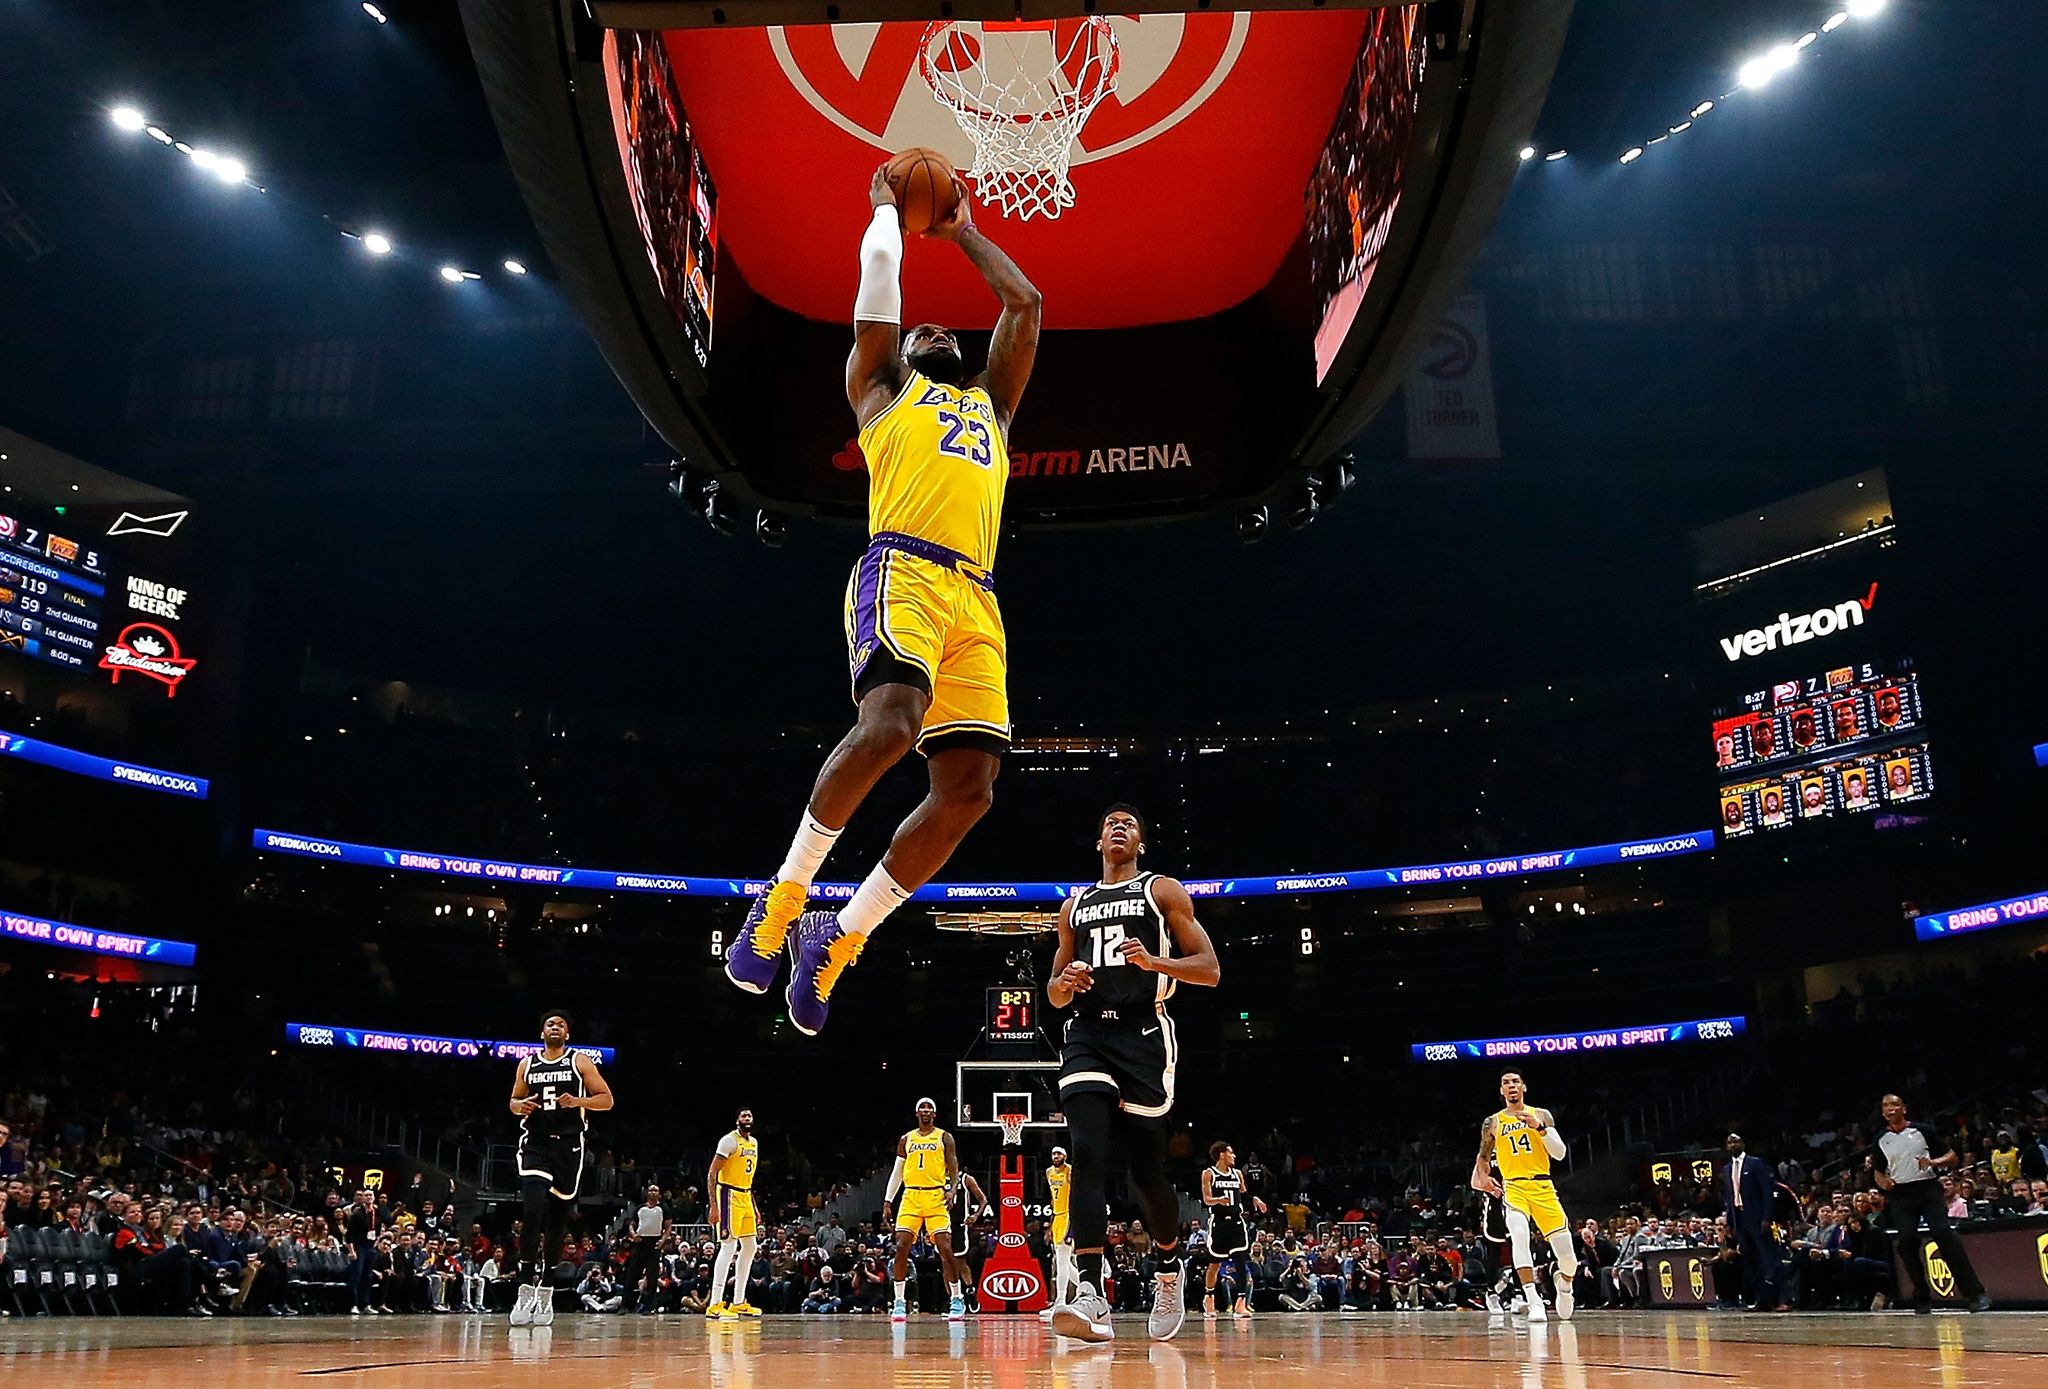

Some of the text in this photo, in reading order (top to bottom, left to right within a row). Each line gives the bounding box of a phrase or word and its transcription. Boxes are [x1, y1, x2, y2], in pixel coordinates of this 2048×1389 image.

[938, 411, 993, 470] 23
[1009, 443, 1192, 477] arm ARENA
[26, 528, 39, 543] 7
[86, 551, 98, 567] 5
[20, 575, 86, 607] 119 FINAL
[126, 575, 187, 605] KING OF
[20, 596, 98, 631] 59 2nd QUARTER
[128, 592, 180, 620] BEERS.
[21, 617, 33, 631] 6
[57, 632, 93, 649] QUARTER
[1720, 600, 1864, 662] verizon
[105, 646, 187, 676] Budweiser
[1744, 691, 1766, 704] 8:27
[1806, 677, 1817, 691] 7
[1862, 663, 1872, 677] 5
[400, 854, 441, 870] BRING
[443, 859, 482, 875] YOUR
[485, 863, 517, 879] OWN
[520, 868, 562, 882] SPIRIT
[825, 885, 854, 897] OWN
[1184, 882, 1223, 895] SPIRIT
[1402, 867, 1441, 882] BRING
[1444, 864, 1482, 878] YOUR
[1486, 860, 1517, 874] OWN
[1521, 854, 1563, 870] SPIRIT
[1075, 899, 1145, 926] PEACHTREE
[1949, 908, 1998, 930] BRING
[5, 916, 146, 954] YOUR OWN SPIRIT
[1090, 924, 1126, 968] 12
[1001, 991, 1030, 1005] 8:27
[997, 1005, 1026, 1028] 21
[1101, 1010, 1119, 1020] ATL
[300, 1026, 334, 1038] SVEDKA
[300, 1035, 334, 1045] VODKA
[1485, 1028, 1668, 1056] BRING YOUR OWN SPIRIT
[411, 1038, 451, 1054] YOUR
[1424, 1044, 1457, 1053] SVEDKA
[1425, 1051, 1458, 1061] VODKA
[528, 1071, 572, 1084] PEACHTREE
[543, 1086, 556, 1111] 5
[1509, 1133, 1532, 1154] 14
[746, 1159, 753, 1173] 3
[918, 1153, 924, 1169] 1
[1003, 1235, 1021, 1244] KIA
[1929, 1258, 1952, 1287] ups
[993, 1277, 1030, 1294] KIA
